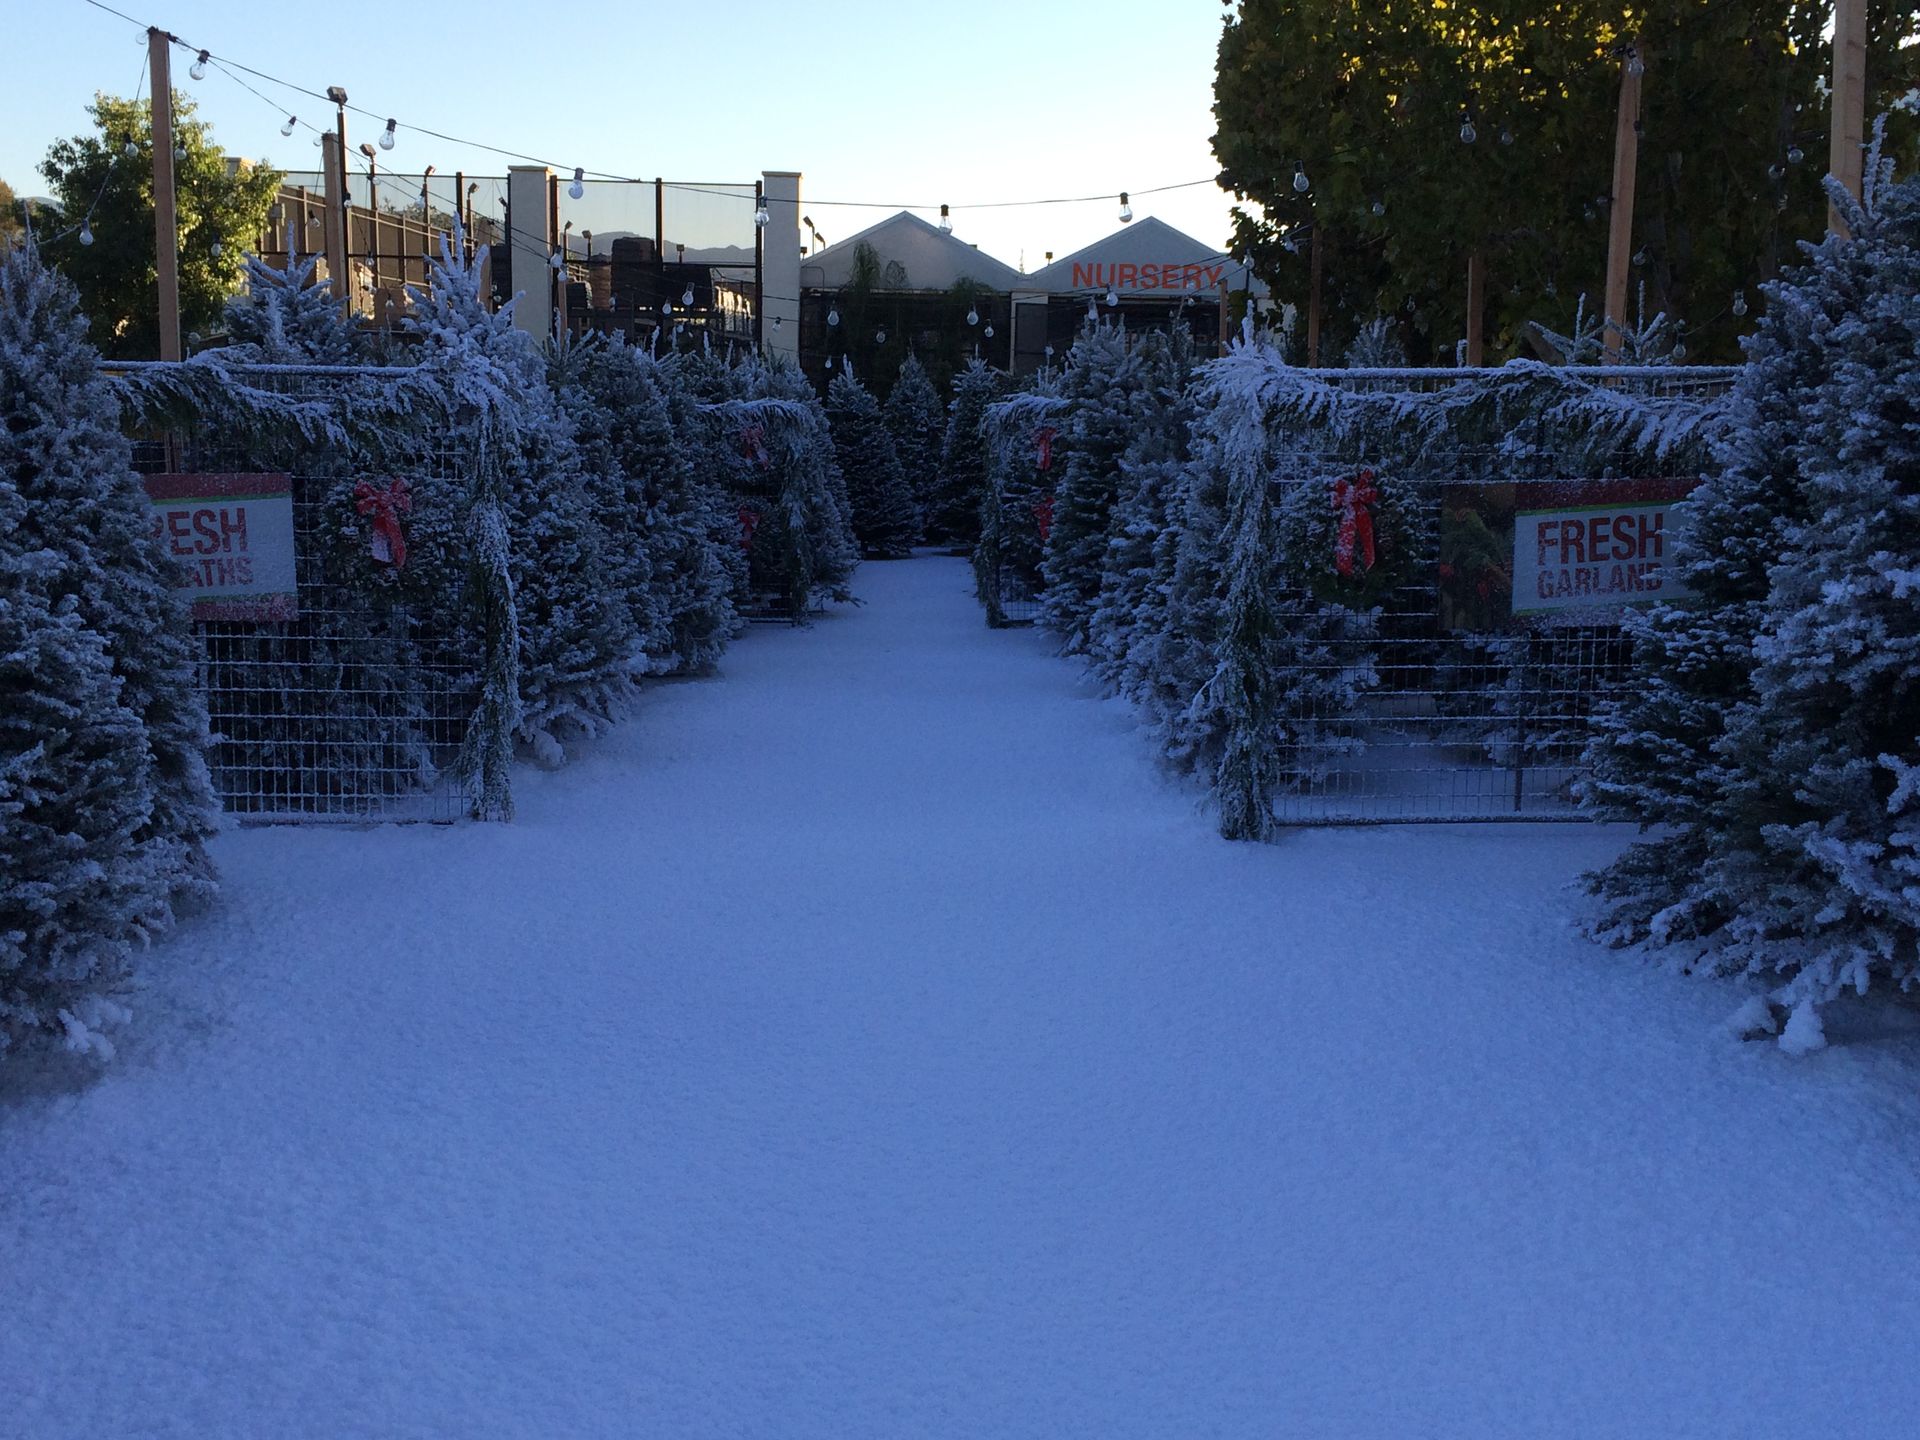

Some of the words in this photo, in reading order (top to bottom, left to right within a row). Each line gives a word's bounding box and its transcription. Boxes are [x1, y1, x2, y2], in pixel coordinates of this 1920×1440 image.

[1072, 262, 1223, 289] NURSERY
[1537, 513, 1664, 566] FRESH
[1537, 562, 1663, 599] GARLAND
